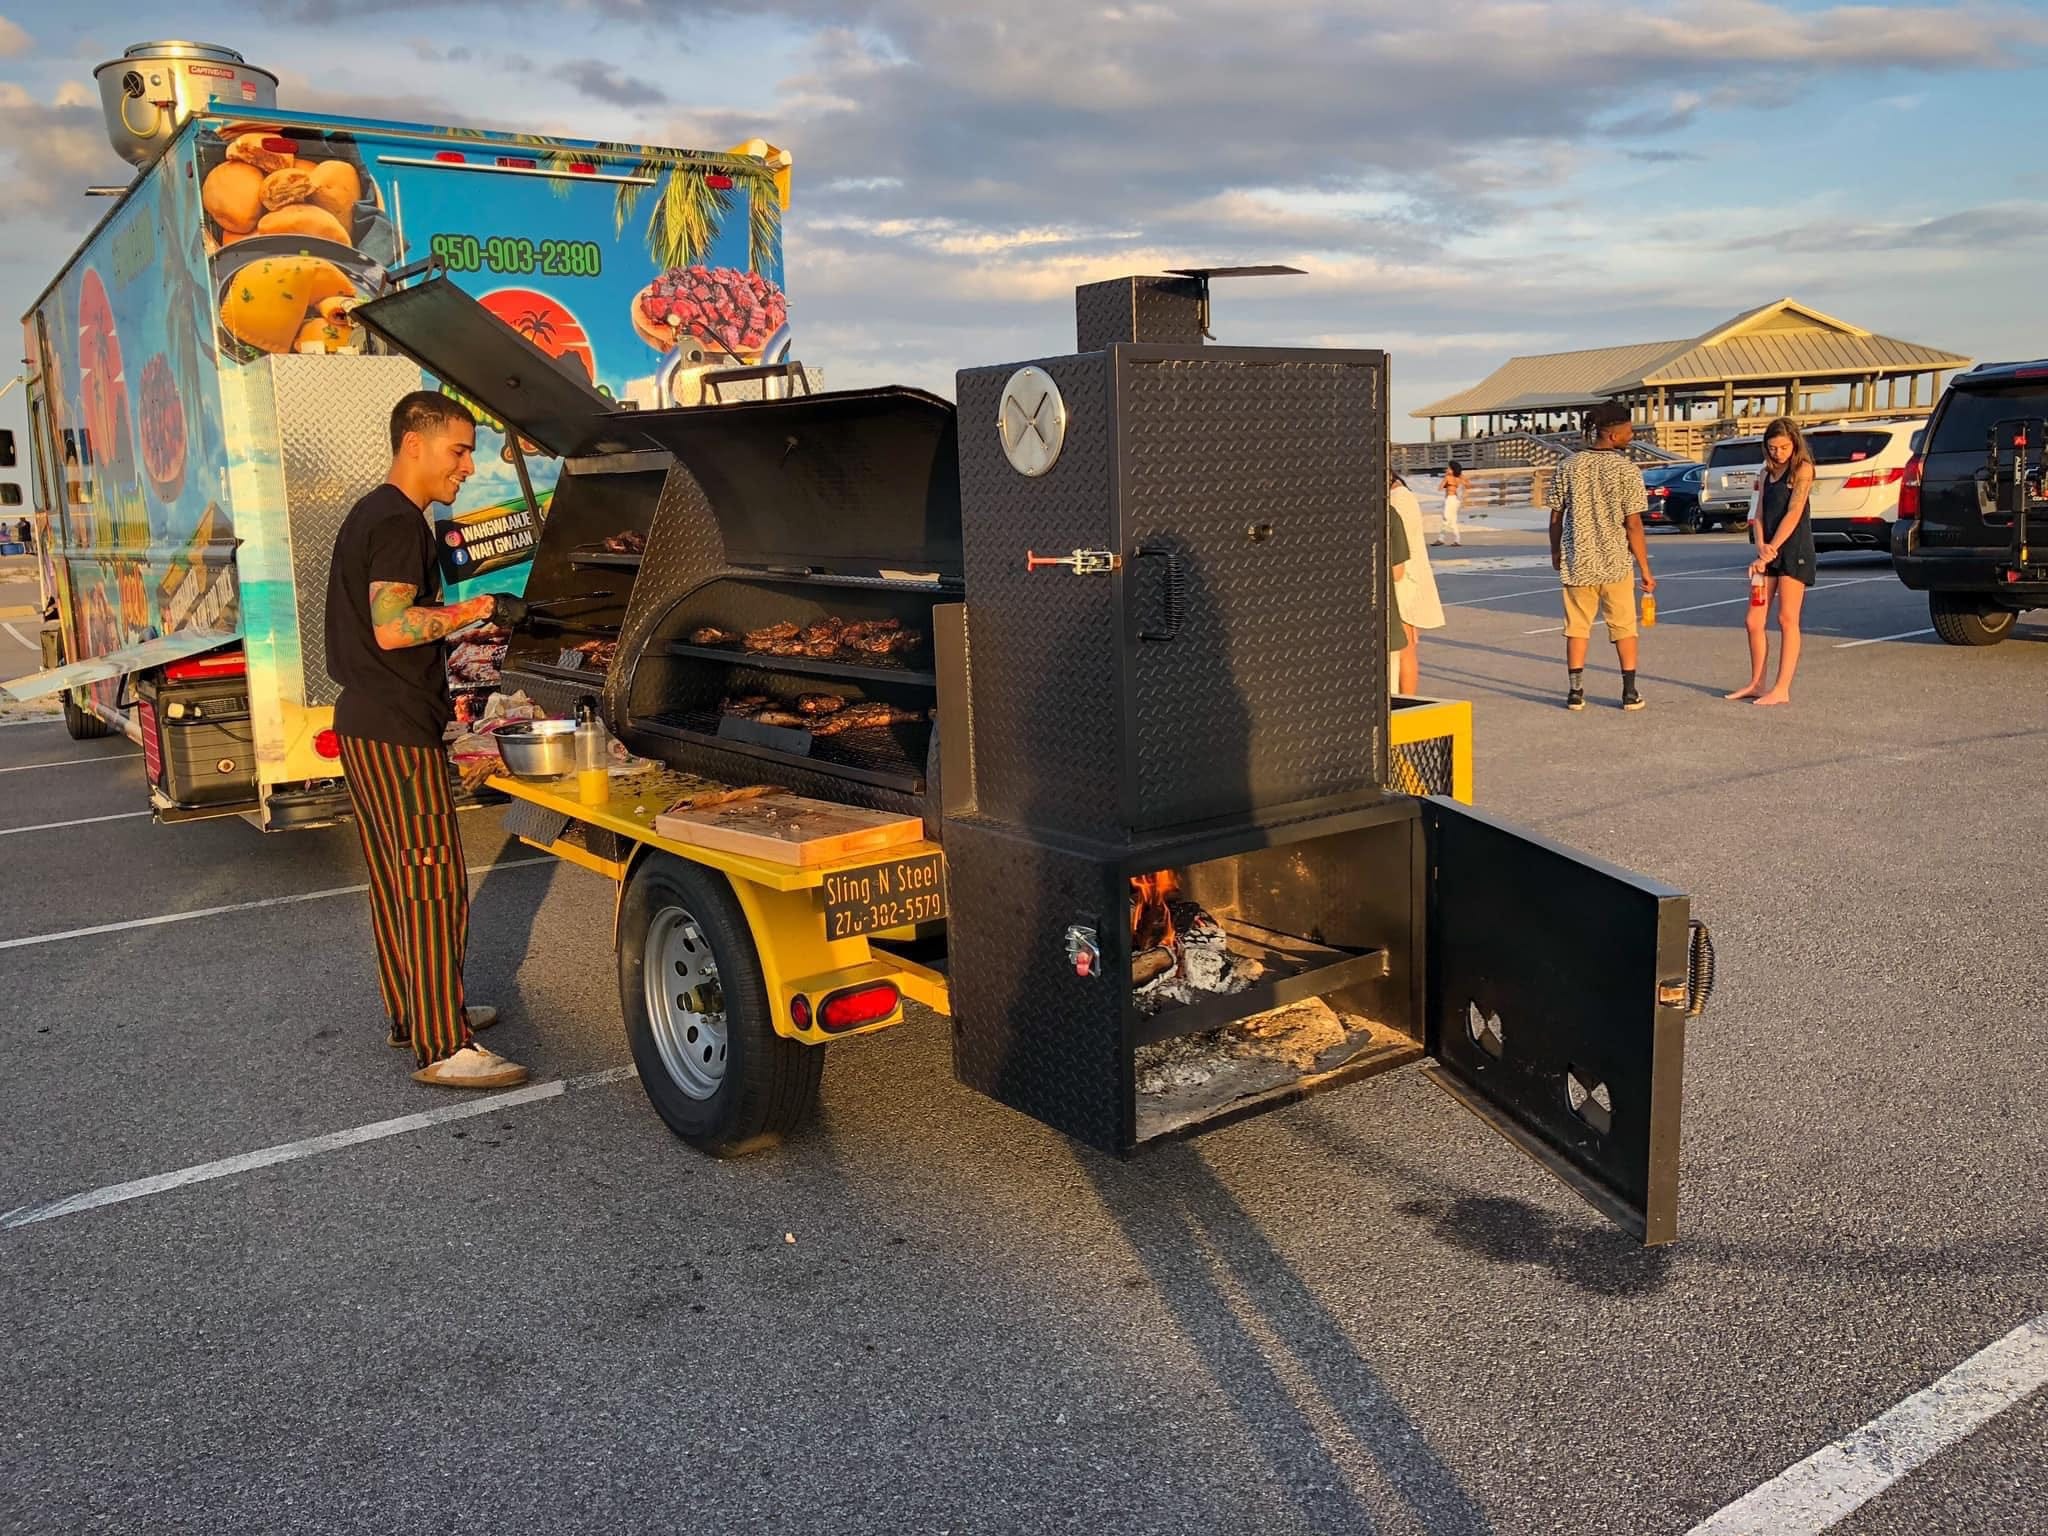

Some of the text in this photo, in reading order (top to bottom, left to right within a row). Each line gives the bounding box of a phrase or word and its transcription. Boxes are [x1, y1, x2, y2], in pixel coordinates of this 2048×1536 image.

[432, 235, 601, 276] 850-903-2380
[461, 511, 533, 543] WAHGWAANJE
[467, 530, 533, 561] WAH GWAAN
[827, 859, 938, 904] Sling N Steel
